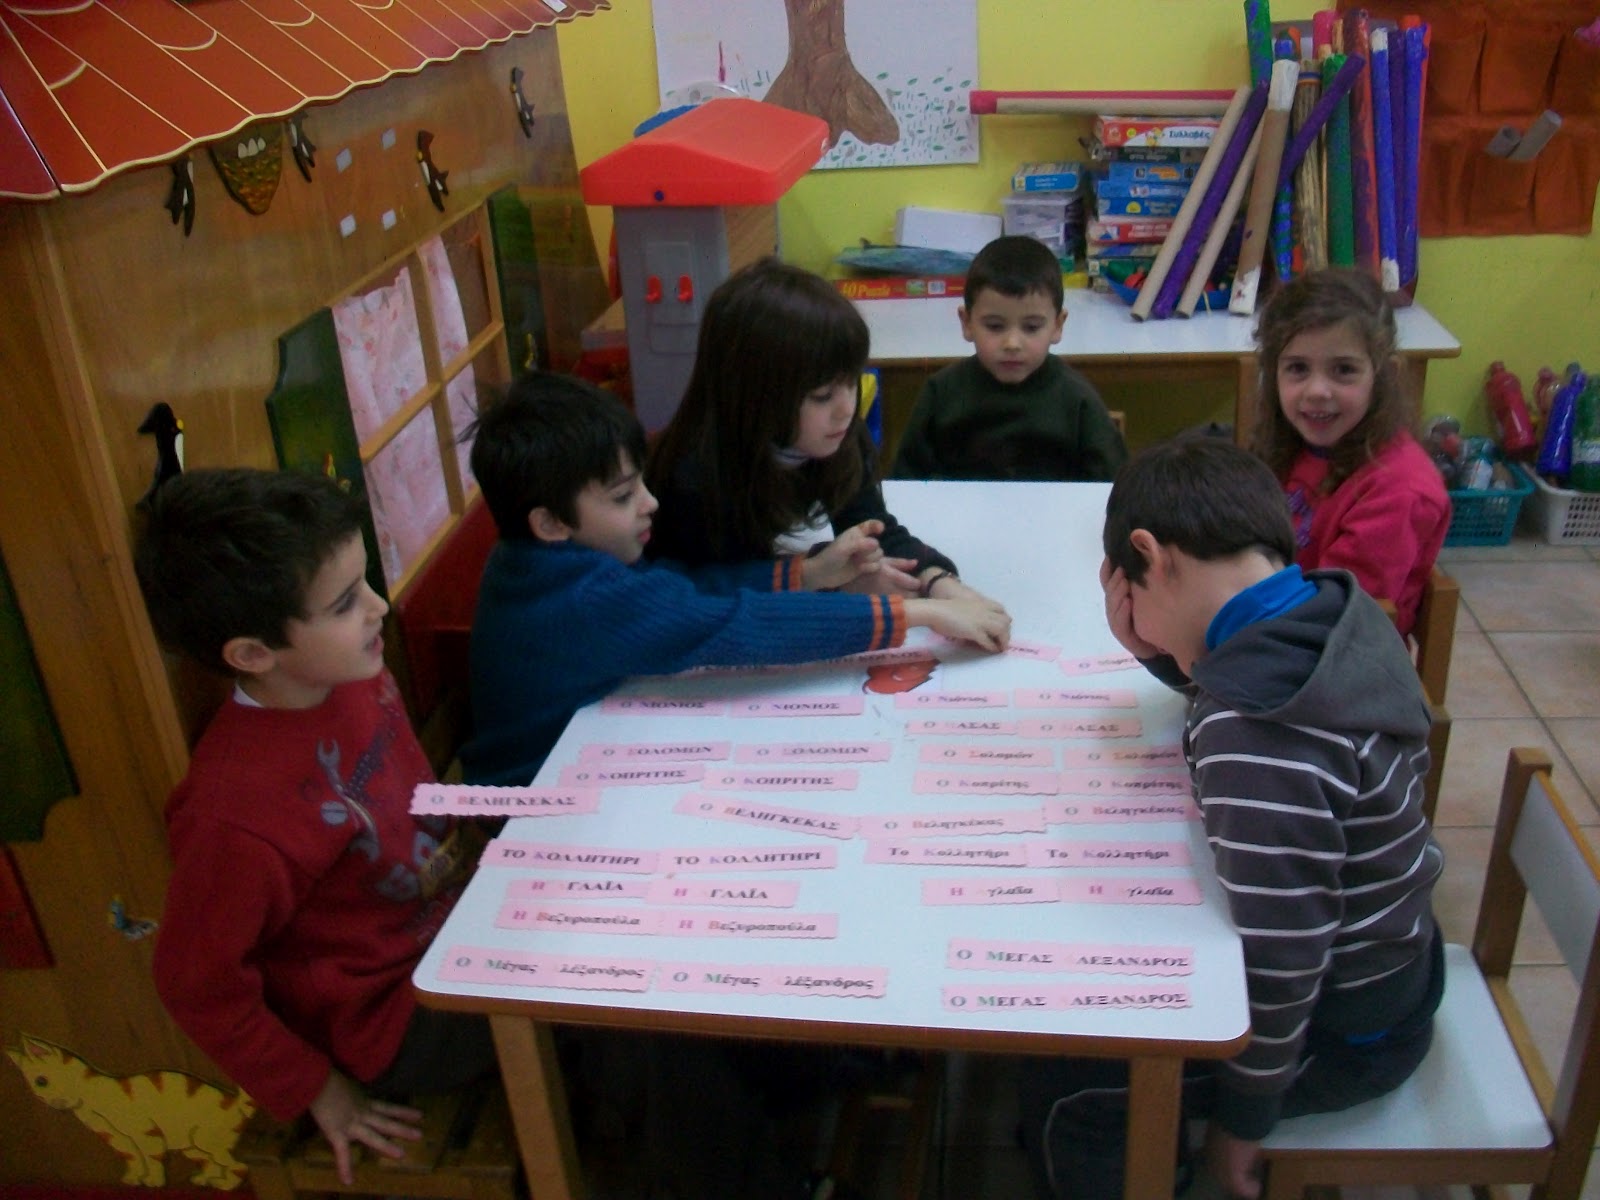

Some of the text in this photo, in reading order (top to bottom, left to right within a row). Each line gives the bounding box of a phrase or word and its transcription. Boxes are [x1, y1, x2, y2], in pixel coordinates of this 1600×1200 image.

[917, 695, 930, 703] Ο
[1039, 693, 1052, 701] Ο
[923, 721, 936, 729] Ο
[1041, 724, 1053, 732] Ο
[602, 748, 615, 756] Ο
[756, 748, 770, 756] Ο
[943, 749, 956, 757] Ο
[1088, 752, 1101, 760] Ο
[576, 772, 590, 780] Ο
[721, 777, 735, 785] Ο
[936, 779, 950, 788] Ο
[1088, 779, 1102, 788] Ο
[430, 794, 577, 806] Ο ΒΕΛΗΓΚΕΚΑΣ
[1064, 806, 1079, 815] Ο
[700, 802, 841, 831] Ο ΒΕΛΗΓΚΕΚΑΣ
[884, 821, 898, 829] Ο
[888, 847, 910, 856] Το
[1046, 848, 1069, 858] Το
[502, 849, 641, 866] ΤΟ ΚΟΛΛΗΤΗΡΙ
[674, 852, 821, 865] ΤΟ ΚΟΛΛΗΤΗΡΙ
[530, 881, 545, 890] Η
[1088, 885, 1103, 895] Η
[673, 887, 688, 897] Η
[950, 887, 963, 896] Η
[512, 910, 528, 920] Η
[678, 919, 694, 929] Η
[957, 948, 973, 960] Ο
[986, 949, 1053, 963] ΜΕΓΑΣ
[455, 957, 471, 967] Ο
[673, 971, 689, 982] Ο
[950, 995, 967, 1007] Ο
[977, 995, 1047, 1006] ΜΕΓΑΣ
